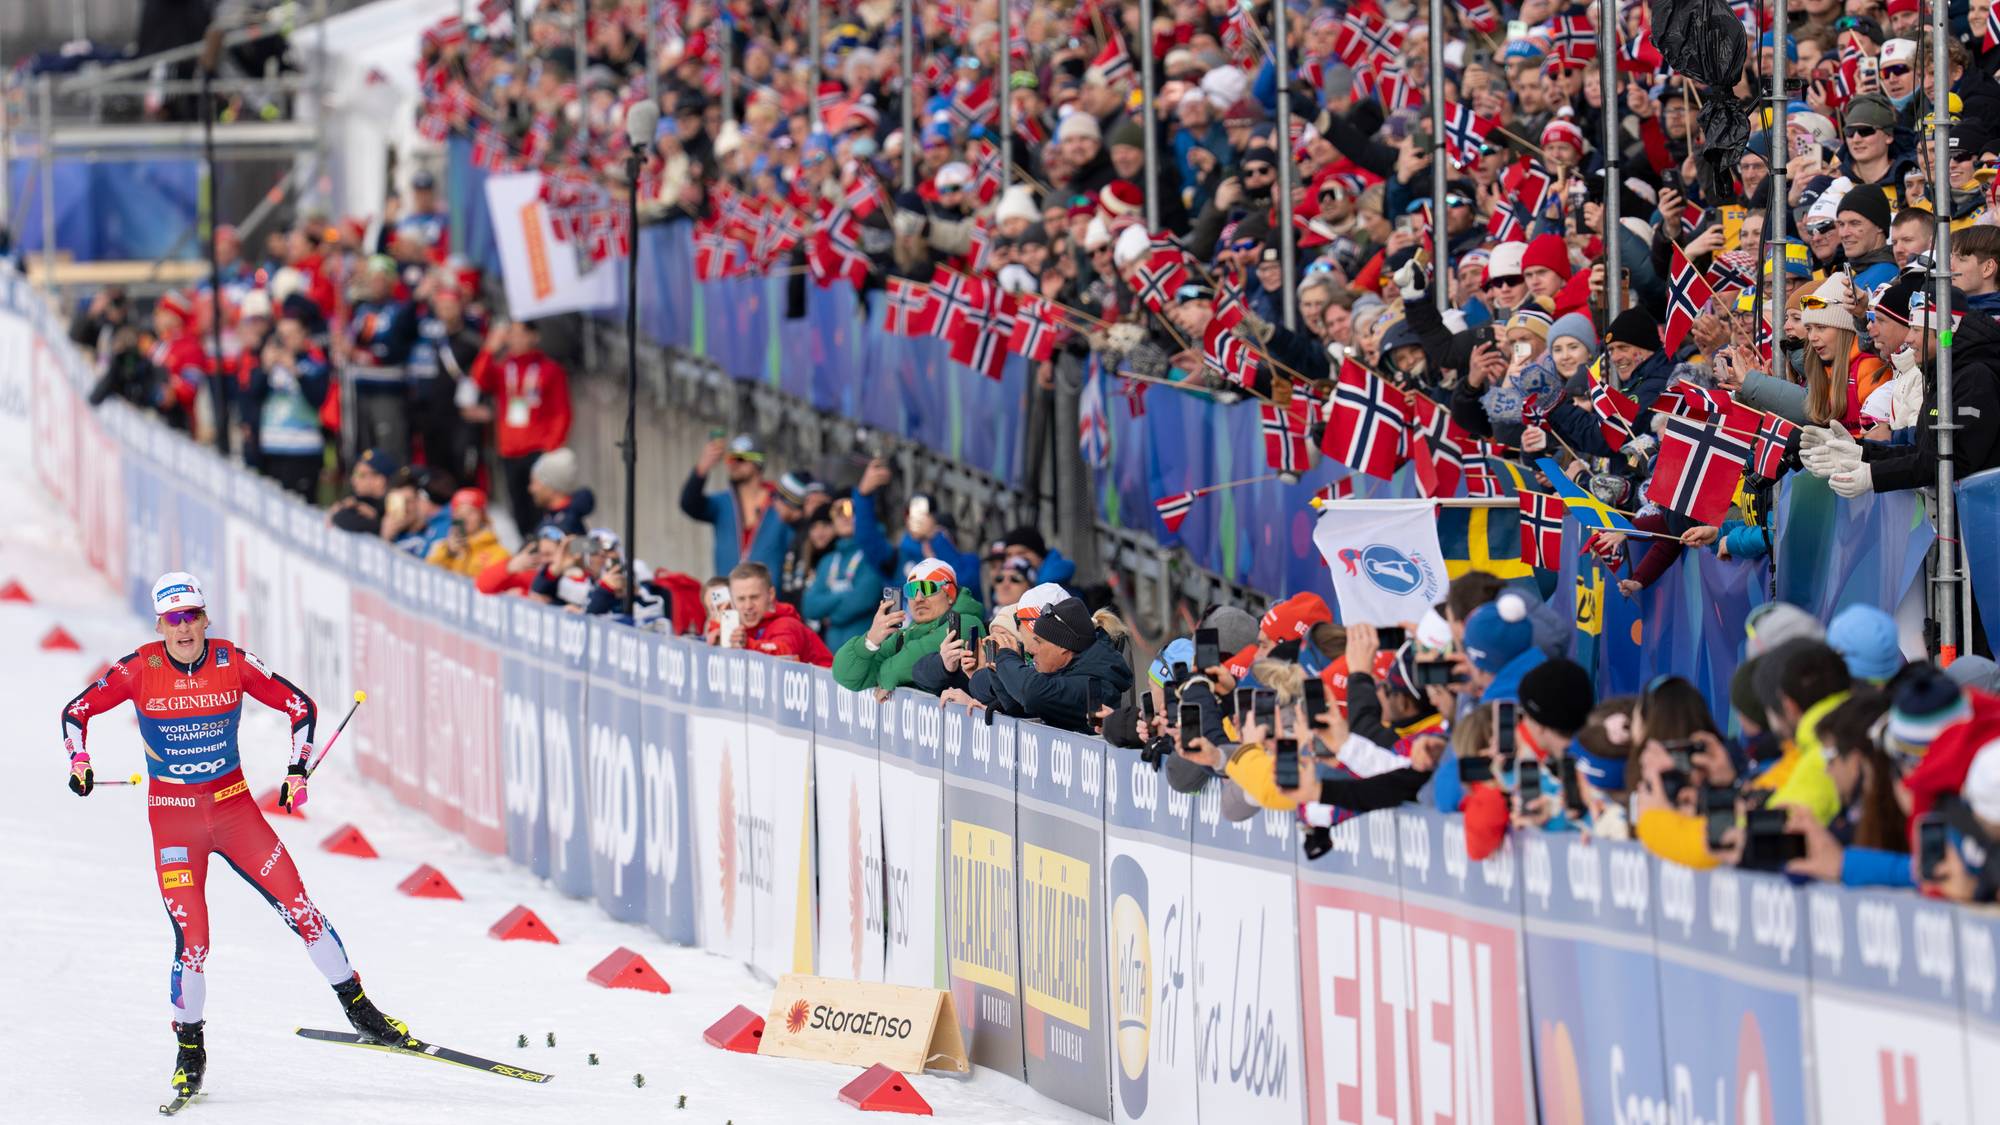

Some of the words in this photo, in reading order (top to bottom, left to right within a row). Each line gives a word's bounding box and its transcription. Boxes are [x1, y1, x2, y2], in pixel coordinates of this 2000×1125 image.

[168, 690, 238, 711] GENERALI
[783, 669, 809, 722] coop
[158, 724, 200, 733] WORLD
[201, 718, 230, 731] 2023
[166, 728, 223, 742] CHAMPION
[917, 704, 940, 759] coop
[164, 740, 227, 756] TRONDHEIM
[168, 757, 226, 775] coop
[1051, 738, 1073, 799] coop
[1081, 747, 1101, 809] coop
[148, 795, 196, 807] ELDORADO
[1131, 760, 1158, 823] coop
[1026, 856, 1088, 1010] BLÅKLÄDER
[810, 1005, 912, 1039] StoraEnso
[1315, 905, 1495, 1125] ELTEN
[490, 1064, 546, 1082] FISCHER
